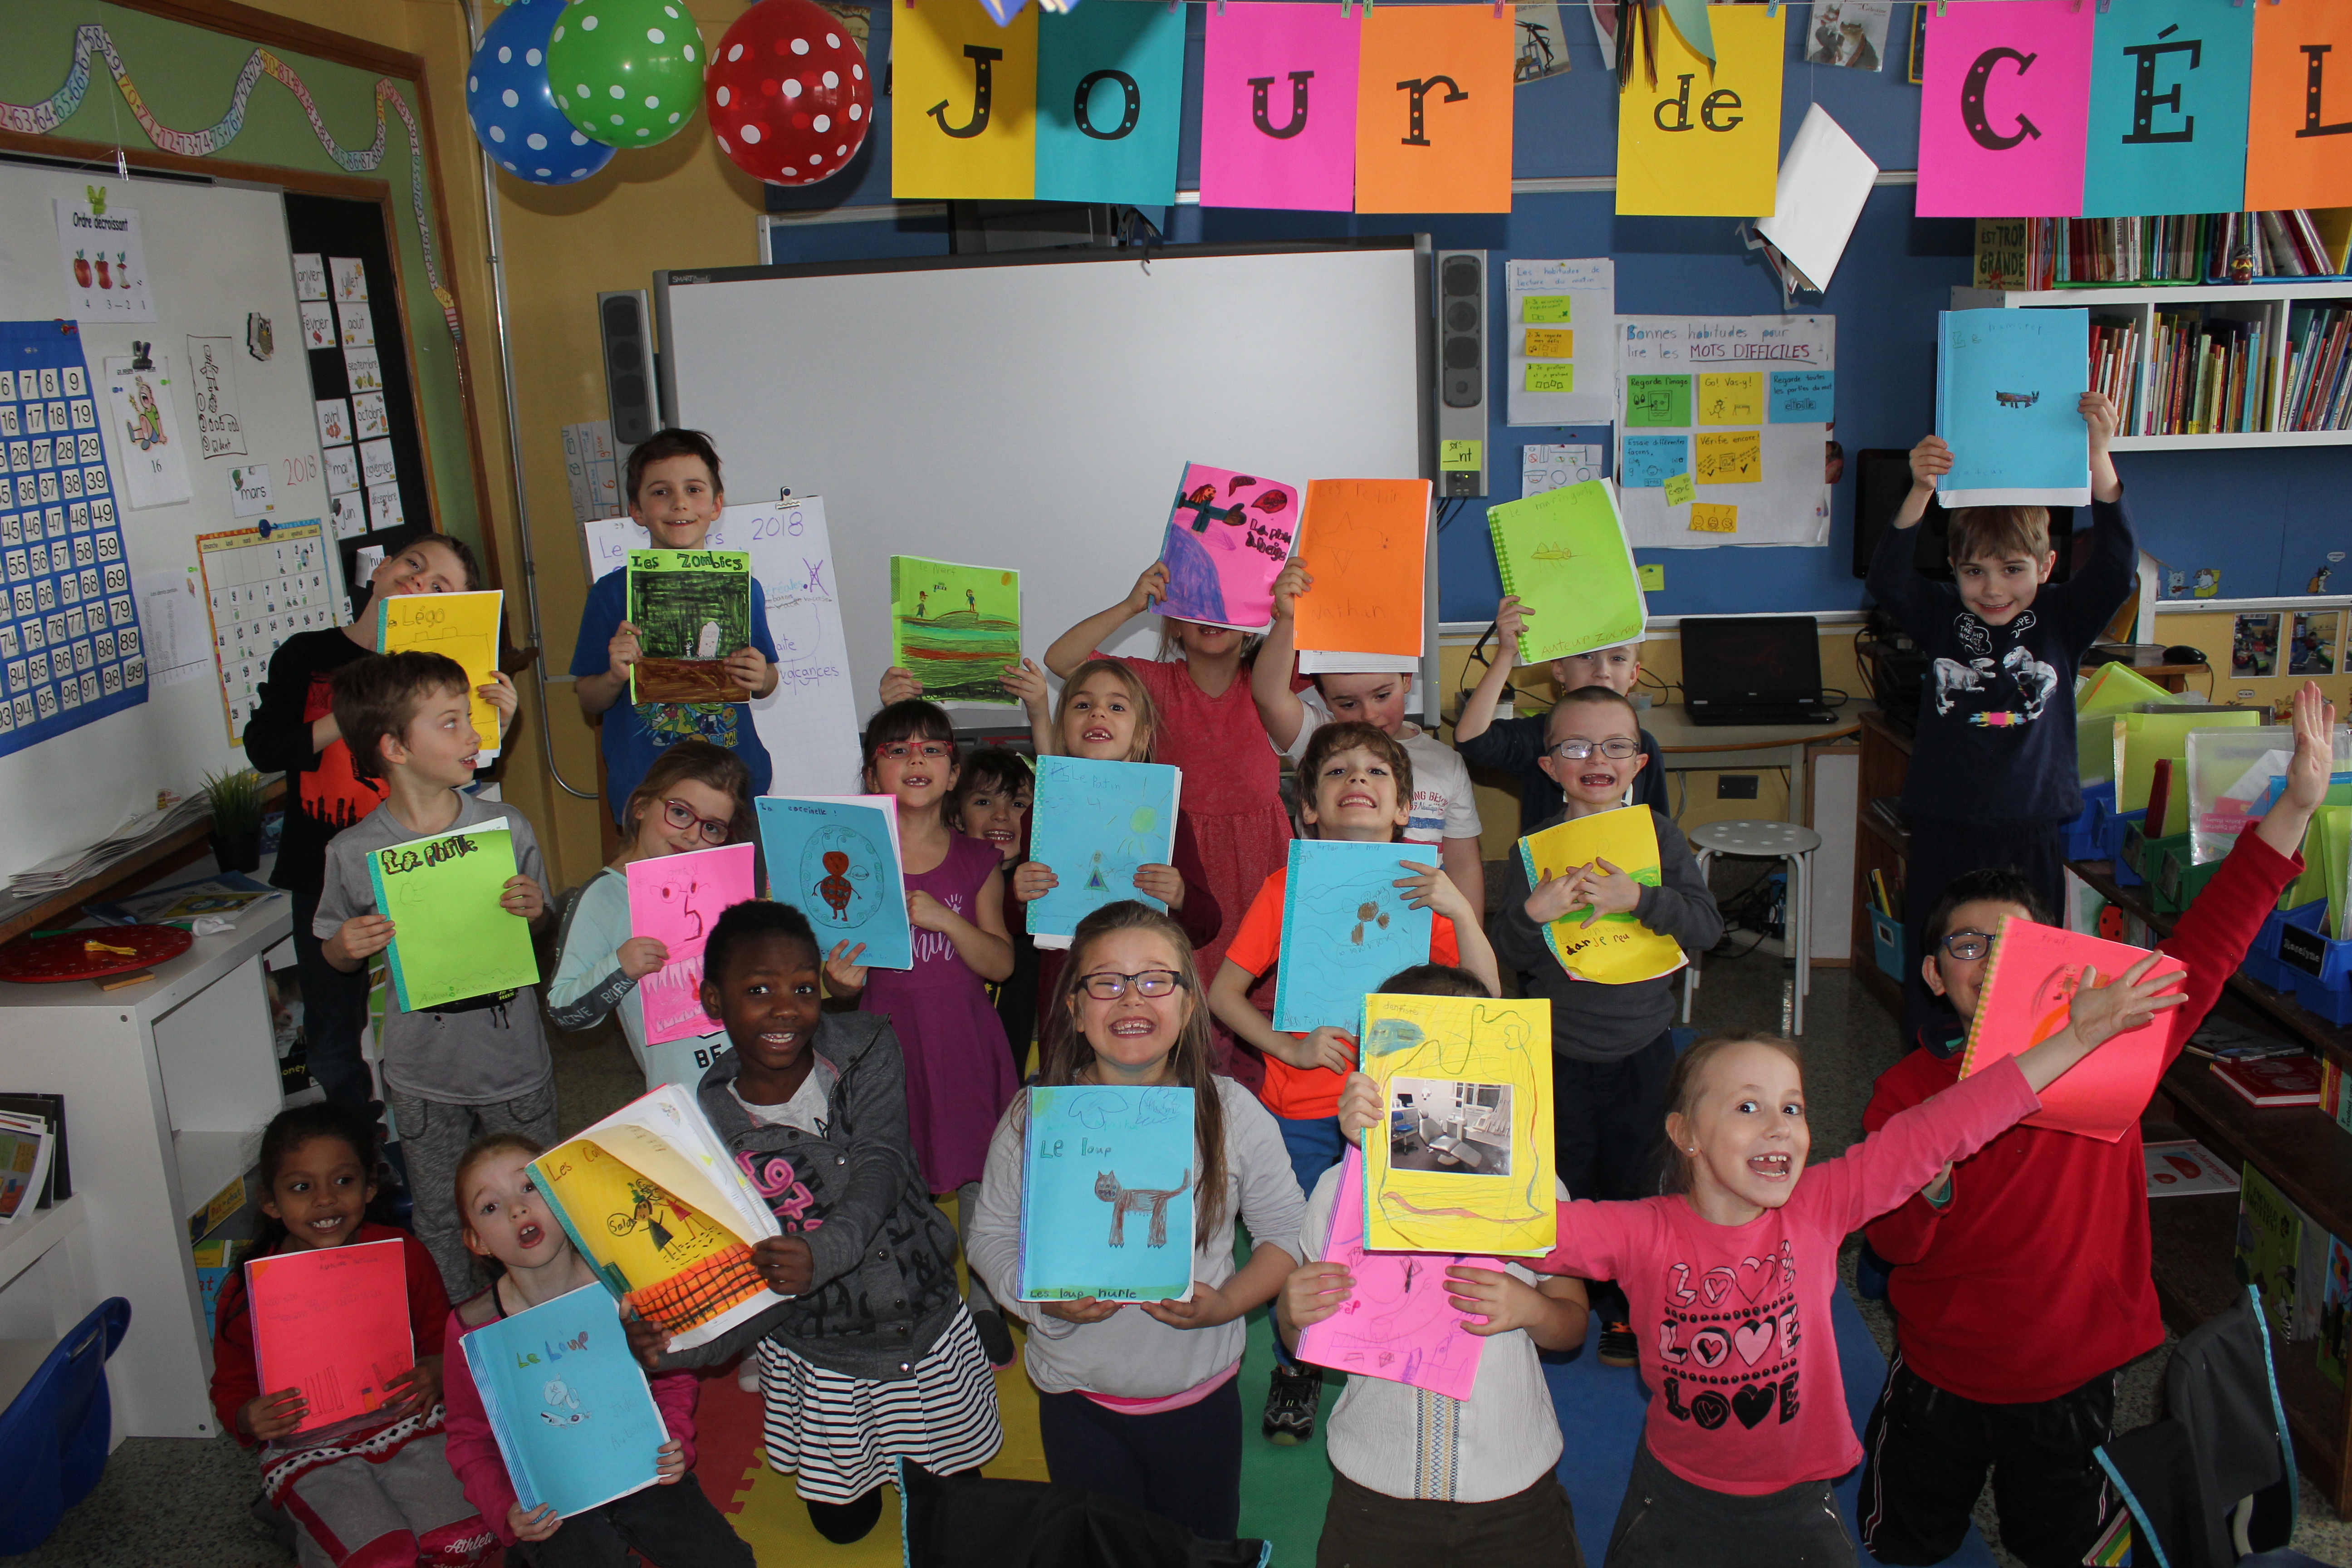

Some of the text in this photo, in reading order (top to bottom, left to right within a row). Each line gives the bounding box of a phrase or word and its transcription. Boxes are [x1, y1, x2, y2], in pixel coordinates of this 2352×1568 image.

[263, 52, 275, 75] 80
[278, 66, 292, 85] 81
[1653, 74, 1744, 132] de
[14, 108, 33, 132] 63
[35, 107, 54, 129] 64
[178, 135, 195, 154] 73
[73, 211, 128, 232] Ordre décroissant
[1981, 223, 2025, 247] EST TROP
[1517, 267, 1533, 275] Les
[1980, 251, 2025, 277] GRANDE
[339, 271, 359, 297] juillet
[85, 299, 131, 309] 4 3 2
[348, 312, 364, 330] août
[1627, 323, 1788, 342] Bonnes habitudes pour
[1627, 343, 1810, 359] lire les MOTS DIFFICILES
[348, 357, 378, 376] septembre
[24, 372, 79, 393] 7 8 9
[1631, 376, 1690, 390] Regarde l'image.
[1705, 377, 1752, 388] Go! Vas-y!
[1774, 375, 1801, 387] Regarde
[1774, 386, 1784, 394] les
[1787, 385, 1809, 395] parties
[28, 405, 90, 427] 17 18 19
[324, 406, 340, 424] avril
[357, 405, 383, 421] octobre
[1653, 436, 1685, 446] différentes
[1700, 433, 1760, 446] Vérifie encore!
[34, 438, 98, 463] 27 28 29
[152, 459, 162, 473] 16
[283, 455, 316, 485] 2018
[333, 458, 348, 475] mai
[365, 459, 392, 475] novembre
[64, 470, 106, 493] 38 39
[240, 485, 266, 500] mars
[371, 489, 398, 505] décembre
[71, 504, 112, 526] 48 49
[341, 505, 356, 530] juin
[599, 511, 804, 558] Le 2018
[76, 538, 118, 561] 58 59
[631, 551, 743, 571] Les Zombies
[933, 563, 957, 575] Nerf
[107, 568, 125, 588] 69
[402, 605, 445, 627] Légo
[98, 632, 137, 657] 88 89
[780, 663, 839, 679] vacances
[1092, 774, 1121, 791] Patin
[2283, 938, 2320, 962] Roselyne
[601, 978, 634, 1004] BORN
[281, 1063, 307, 1077] oney
[1040, 1137, 1112, 1158] Le loup
[545, 1161, 573, 1182] Les
[1030, 1290, 1049, 1298] Les
[1059, 1288, 1084, 1299] loup
[517, 1331, 588, 1369] Le Loup
